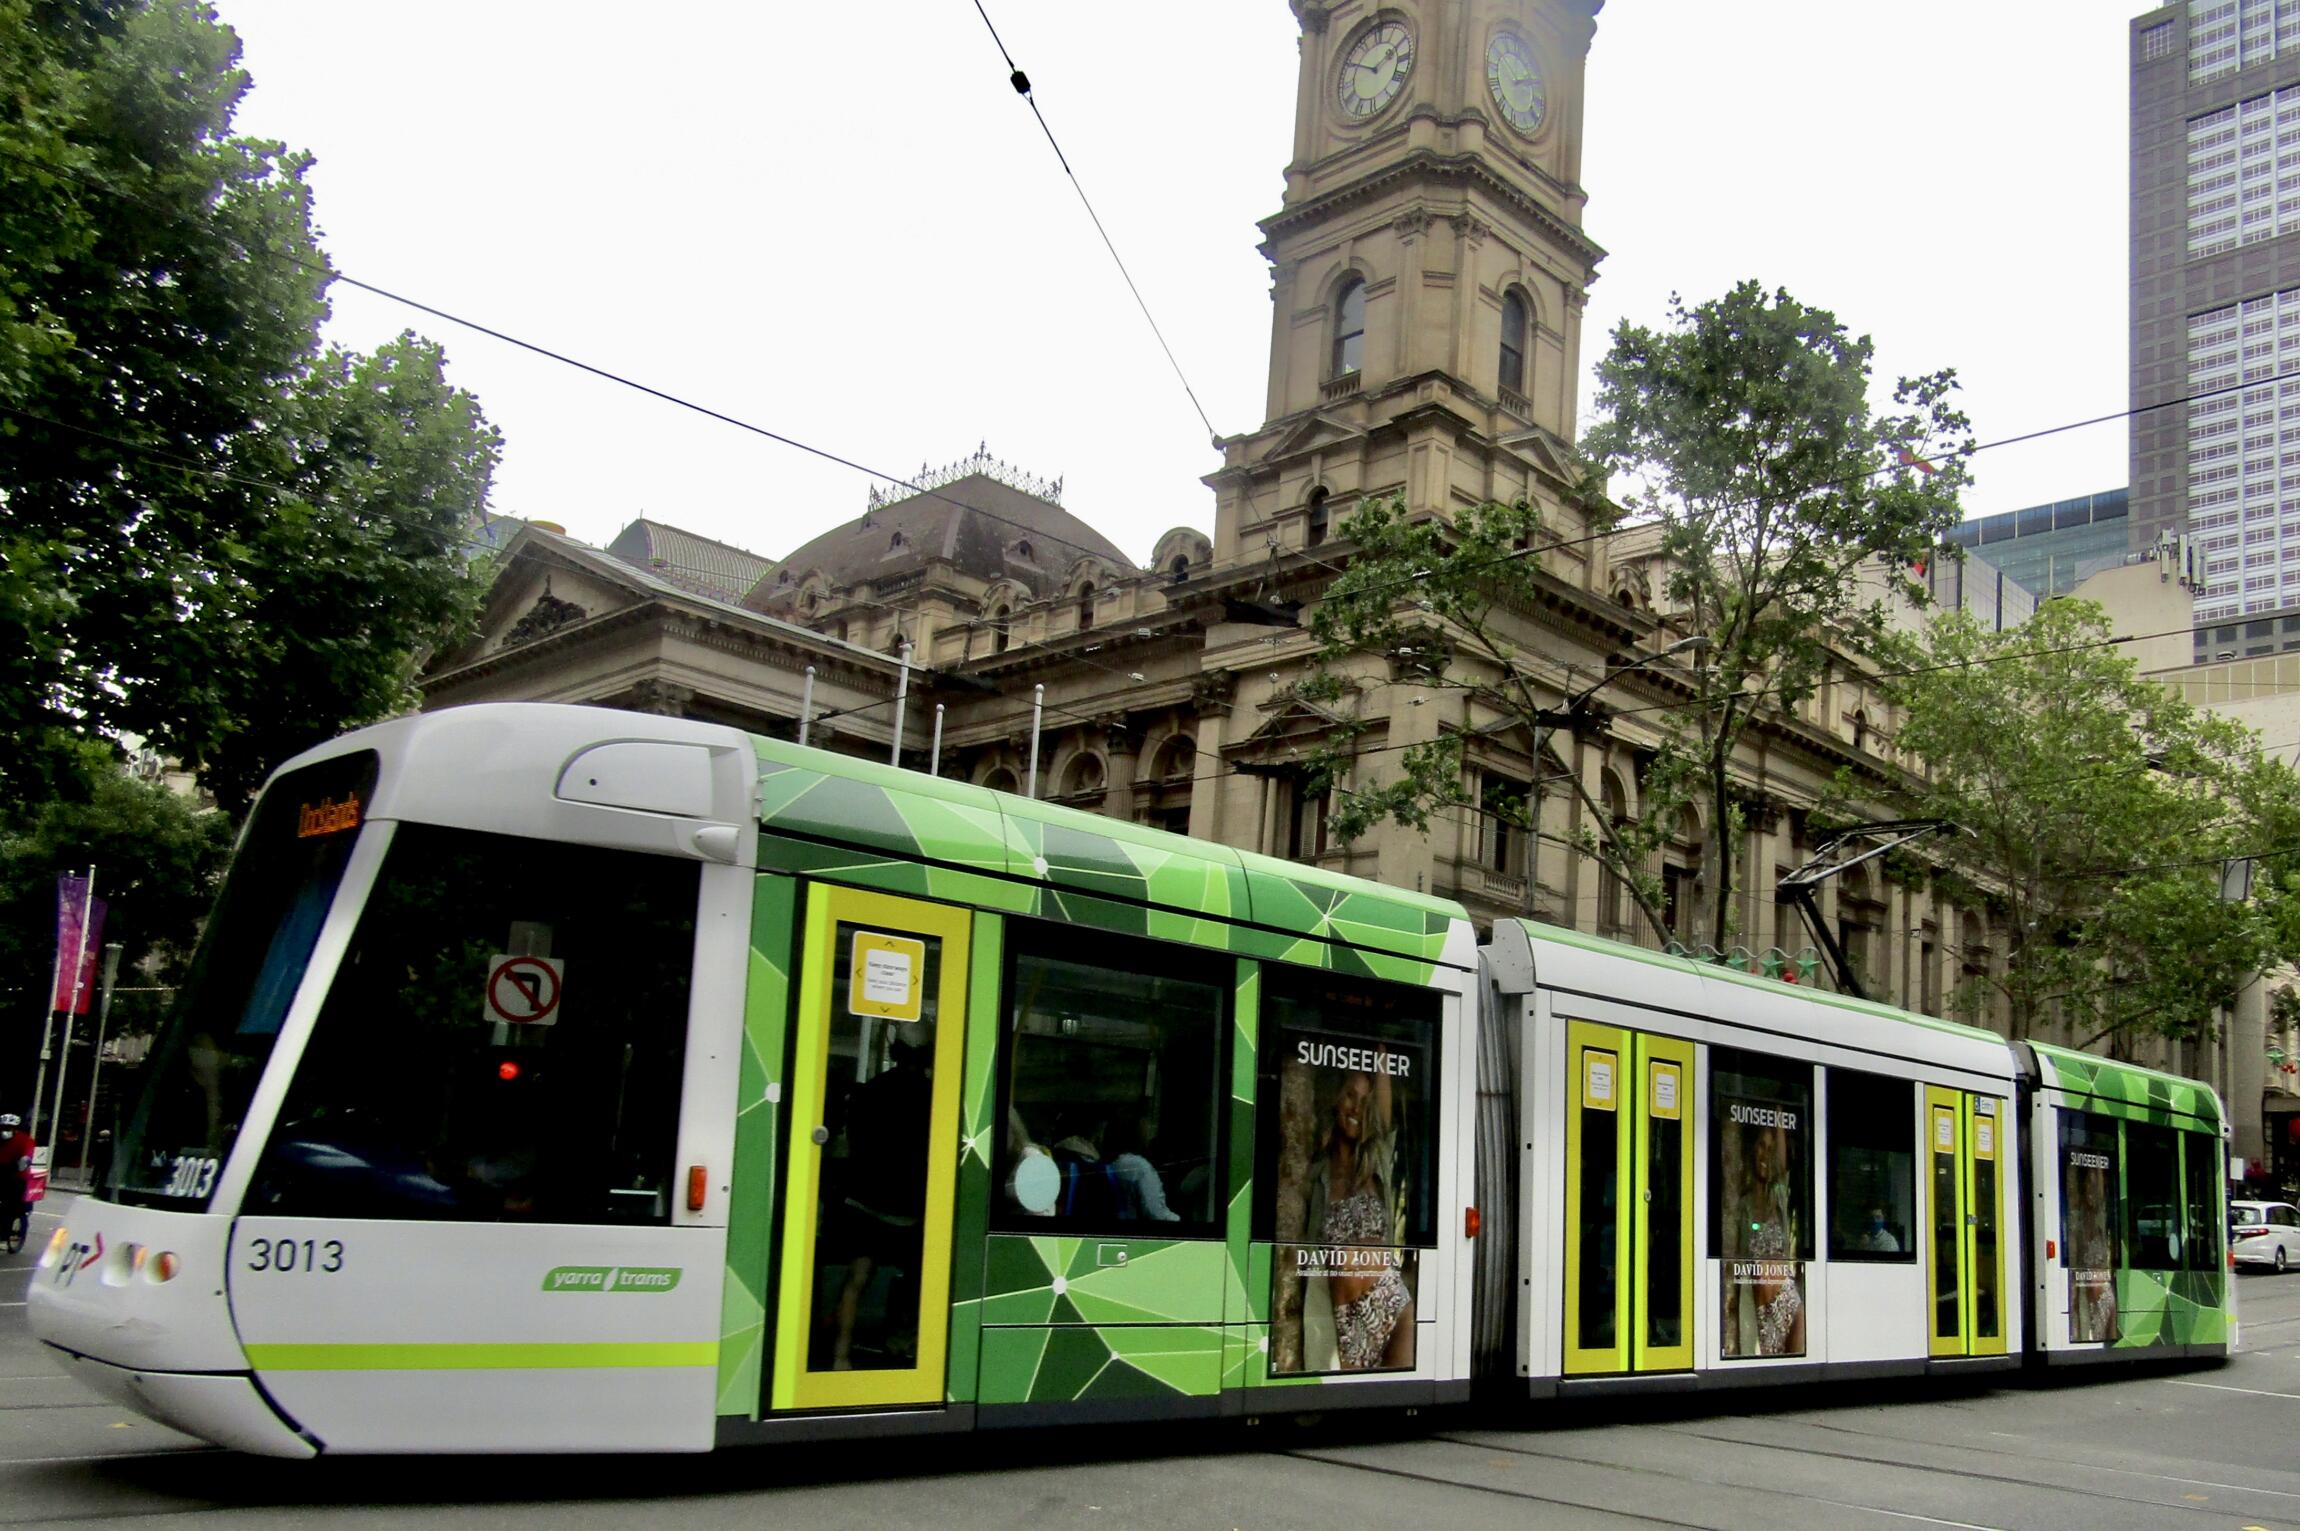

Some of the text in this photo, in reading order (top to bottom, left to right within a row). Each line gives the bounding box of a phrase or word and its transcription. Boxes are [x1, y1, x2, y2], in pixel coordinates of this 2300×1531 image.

[1297, 1041, 1410, 1077] SUNSEEKER
[1730, 1104, 1796, 1130] SUNSEEKER
[2070, 1151, 2110, 1169] SUNSEEKER
[165, 1156, 218, 1198] 3013
[249, 1238, 344, 1273] 3013
[1297, 1249, 1402, 1268] DAVID JONES
[554, 1271, 671, 1289] yarra trams
[1733, 1263, 1763, 1276] DAVID
